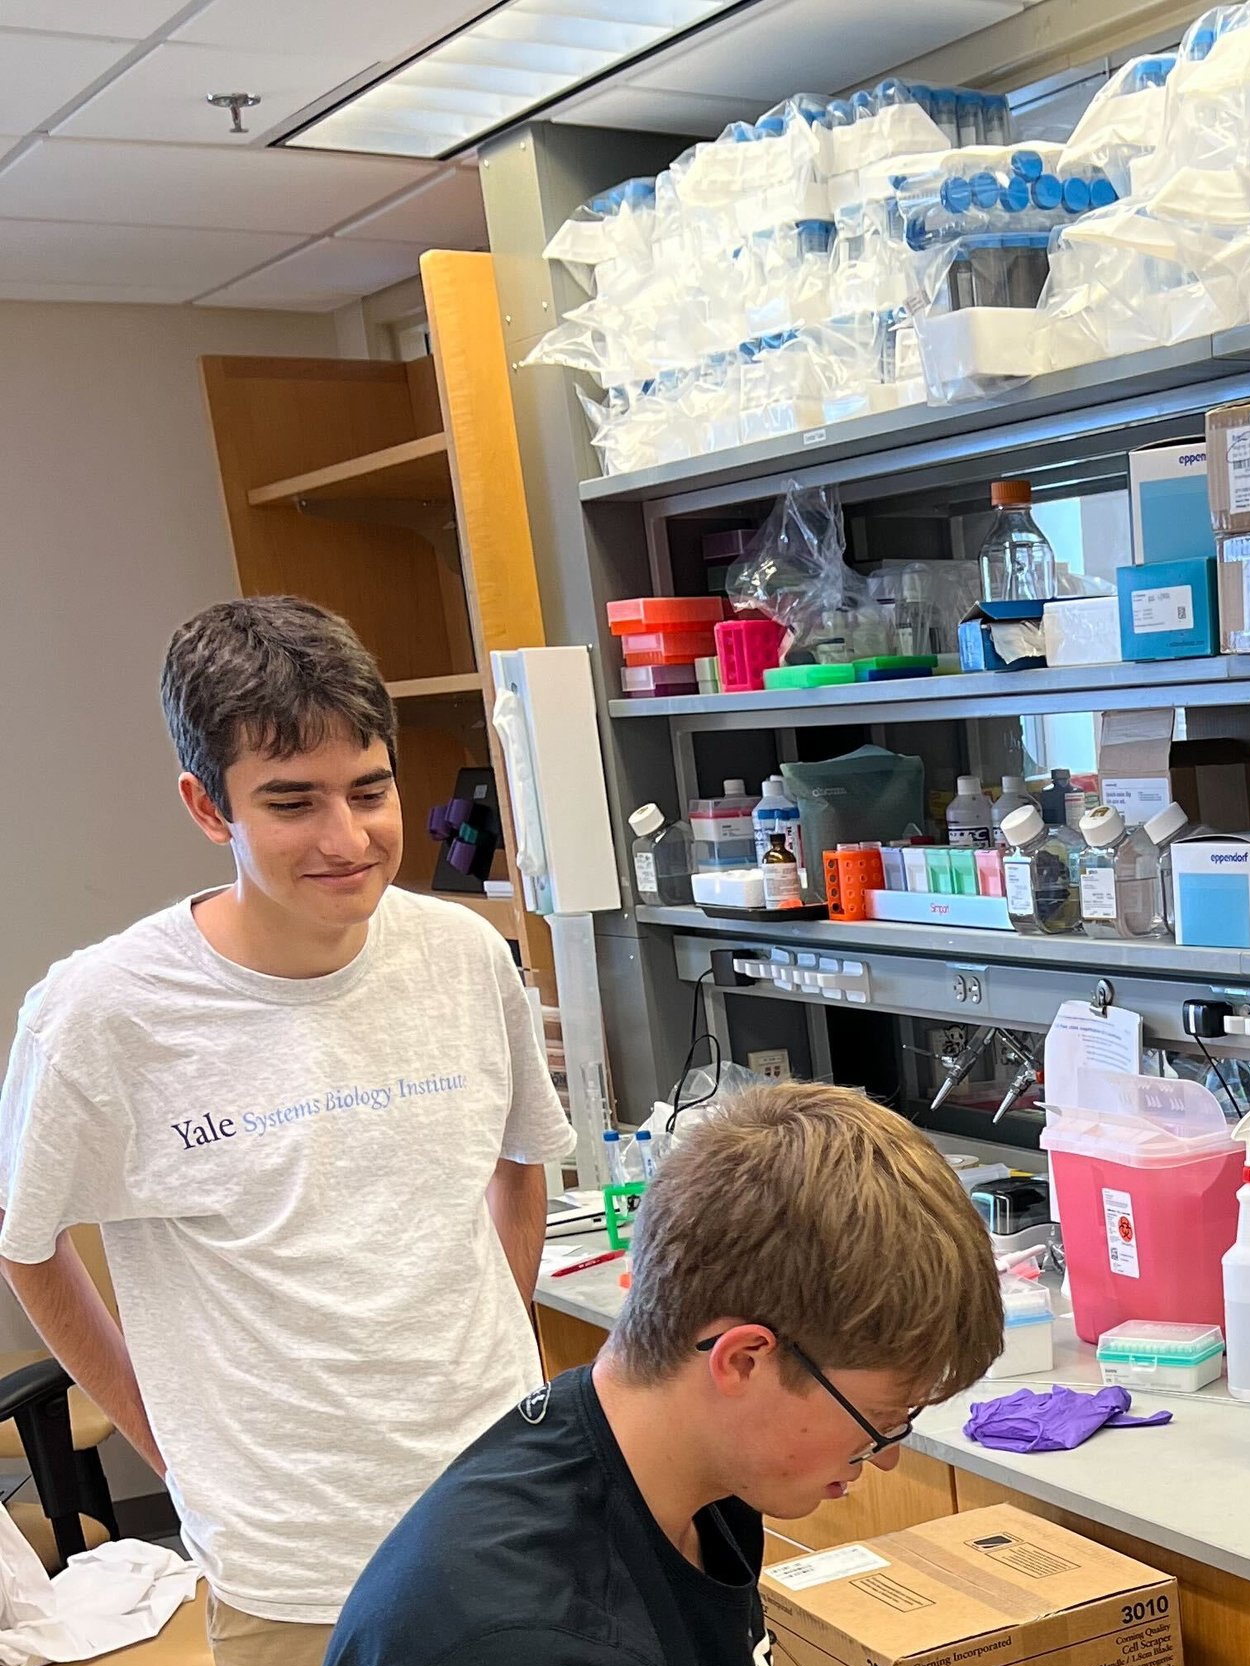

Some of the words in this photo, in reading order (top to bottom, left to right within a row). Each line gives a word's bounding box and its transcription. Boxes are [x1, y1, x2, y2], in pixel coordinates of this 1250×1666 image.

[1178, 452, 1207, 466] eppen
[1210, 852, 1249, 865] eppendorf
[171, 1112, 237, 1150] Yale
[243, 1097, 320, 1137] Systems
[325, 1085, 392, 1111] Biology
[1121, 1595, 1169, 1625] 3010
[1116, 1630, 1144, 1646] Corning
[1146, 1622, 1170, 1639] Quality
[1121, 1641, 1138, 1655] Cell
[1140, 1634, 1172, 1652] Scraper
[953, 1636, 1013, 1662] Incorporated
[1153, 1644, 1173, 1657] Blade
